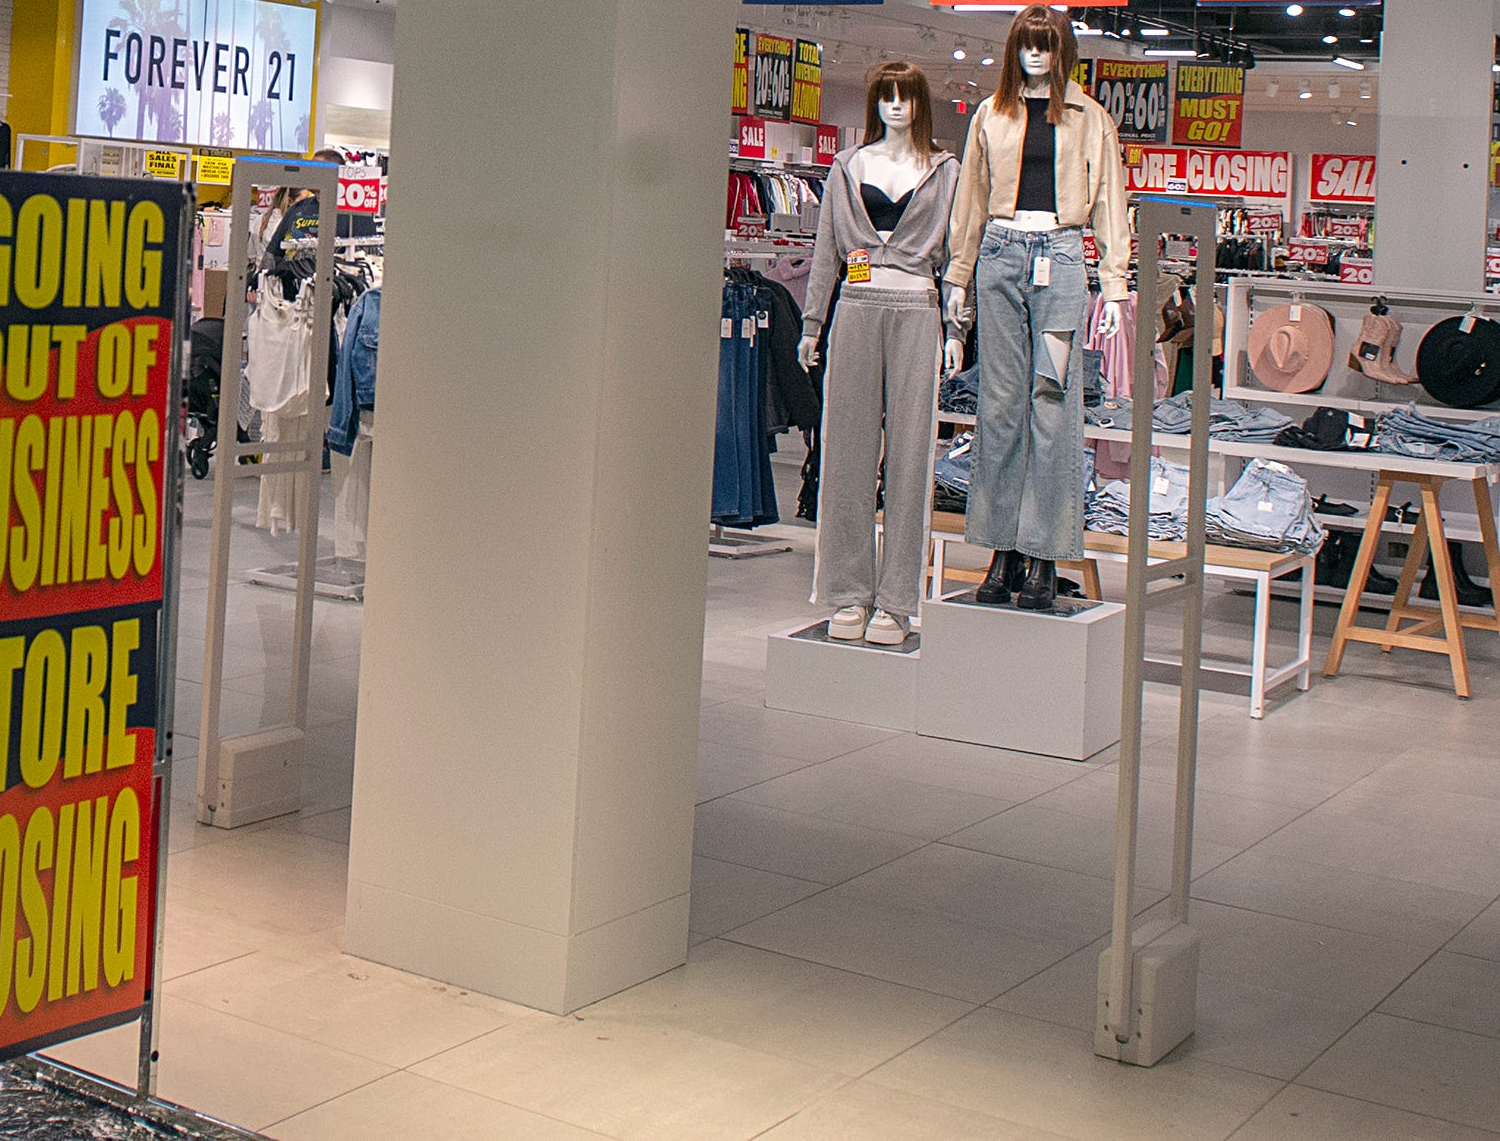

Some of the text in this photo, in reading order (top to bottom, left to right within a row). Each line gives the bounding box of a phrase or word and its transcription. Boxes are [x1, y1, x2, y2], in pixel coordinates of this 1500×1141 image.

[102, 28, 296, 102] FOREVER 21
[1102, 62, 1167, 78] EVERYTHING
[1177, 65, 1243, 95] EVERYTHING
[1179, 98, 1240, 120] MUST
[741, 125, 764, 147] SALE
[1187, 120, 1231, 142] GO!
[818, 135, 836, 155] SALE
[148, 154, 177, 163] SALES
[149, 161, 175, 170] FINAL
[1187, 154, 1287, 194] CLOSING
[96, 323, 159, 399] OF
